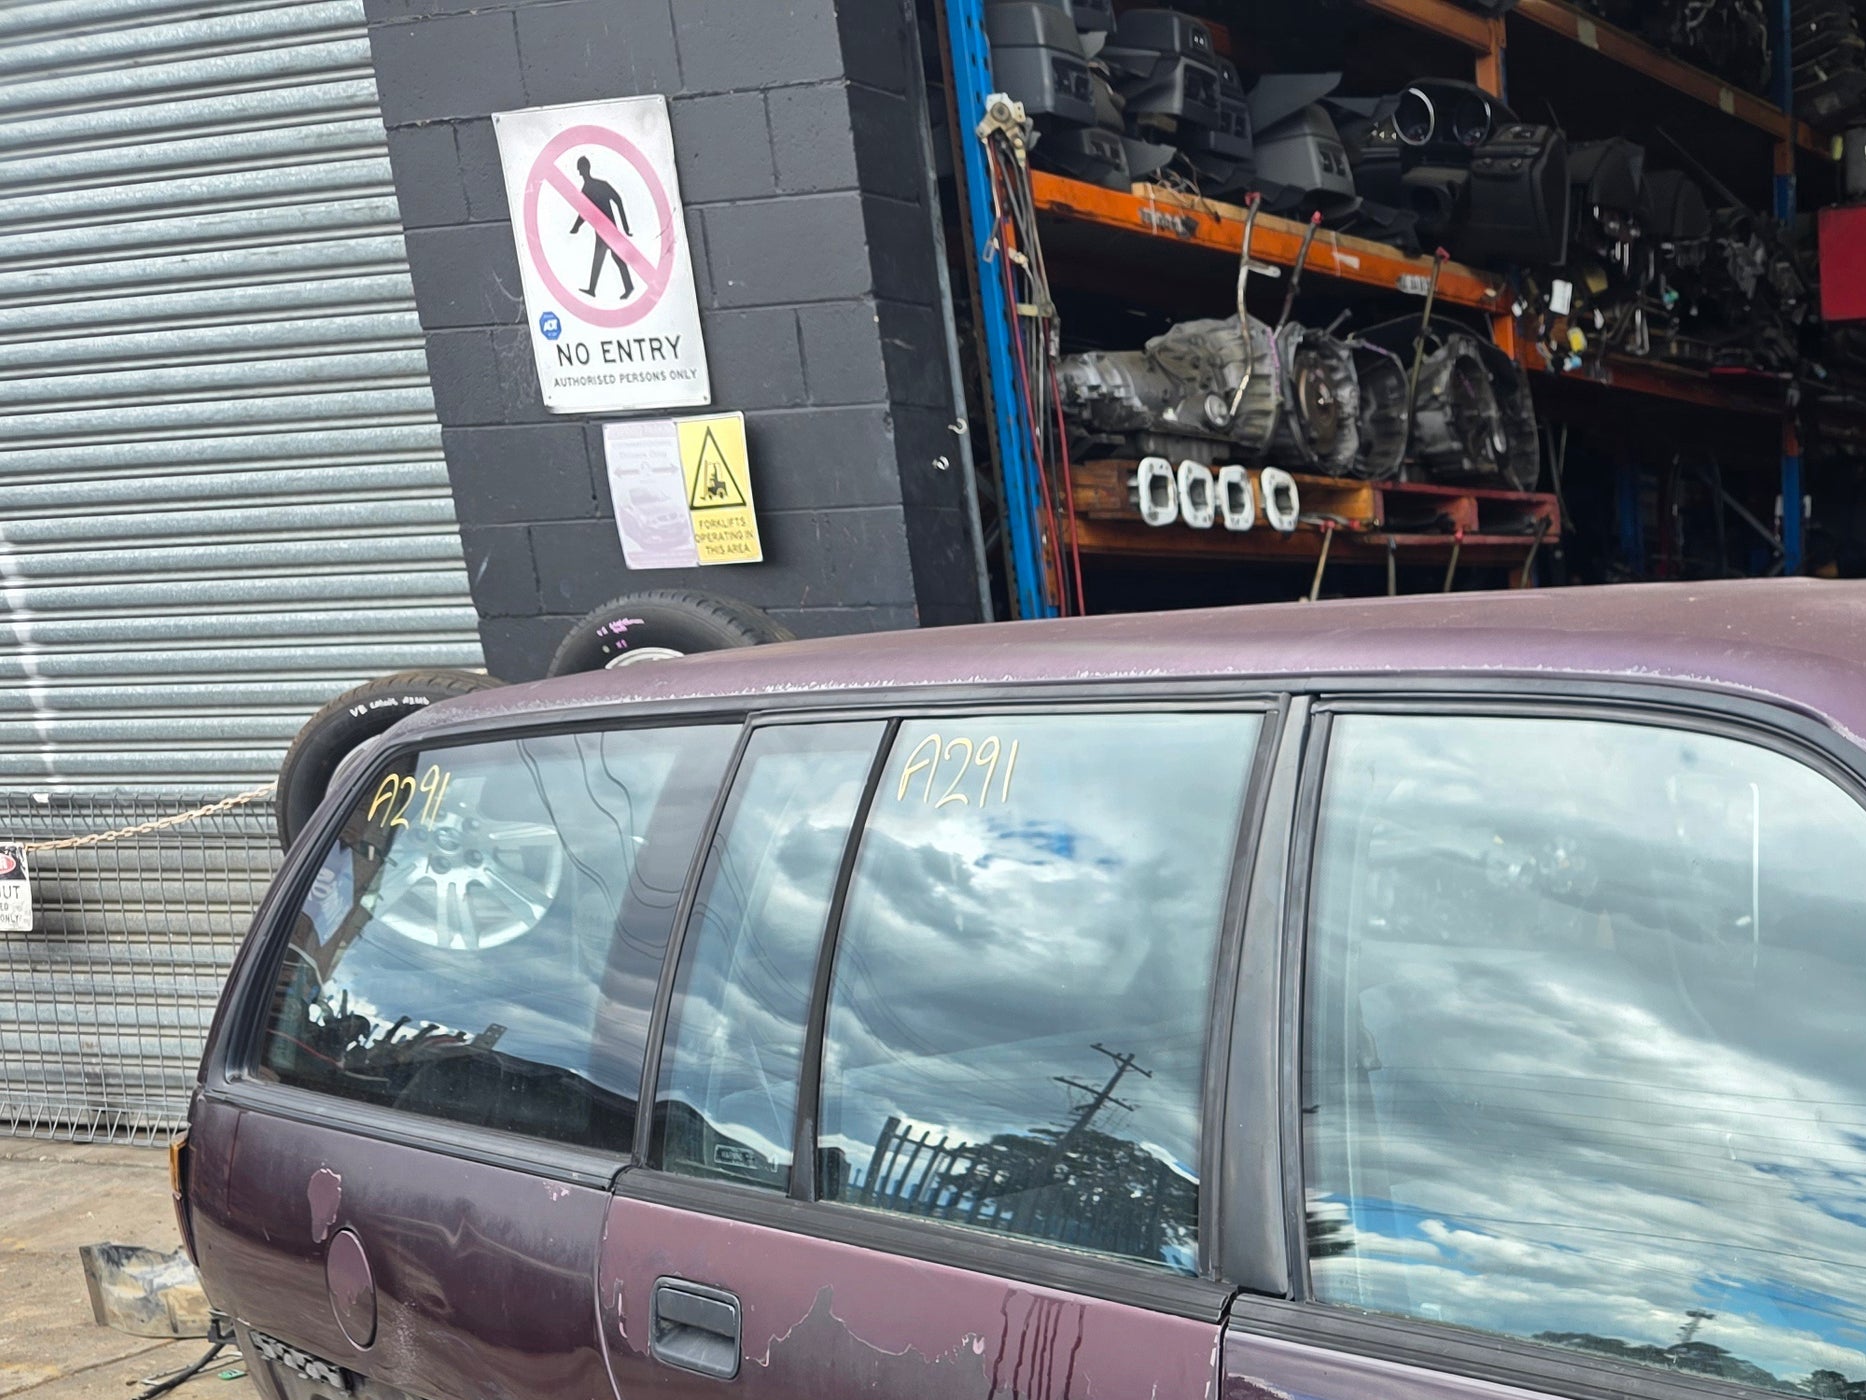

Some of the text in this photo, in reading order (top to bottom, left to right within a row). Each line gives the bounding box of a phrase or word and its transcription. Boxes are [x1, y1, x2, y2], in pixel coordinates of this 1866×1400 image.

[556, 335, 681, 367] NO ENTRY
[554, 369, 698, 388] AUTHORISED PERSONS ONLY
[897, 733, 1019, 809] A291
[367, 764, 451, 832] A291
